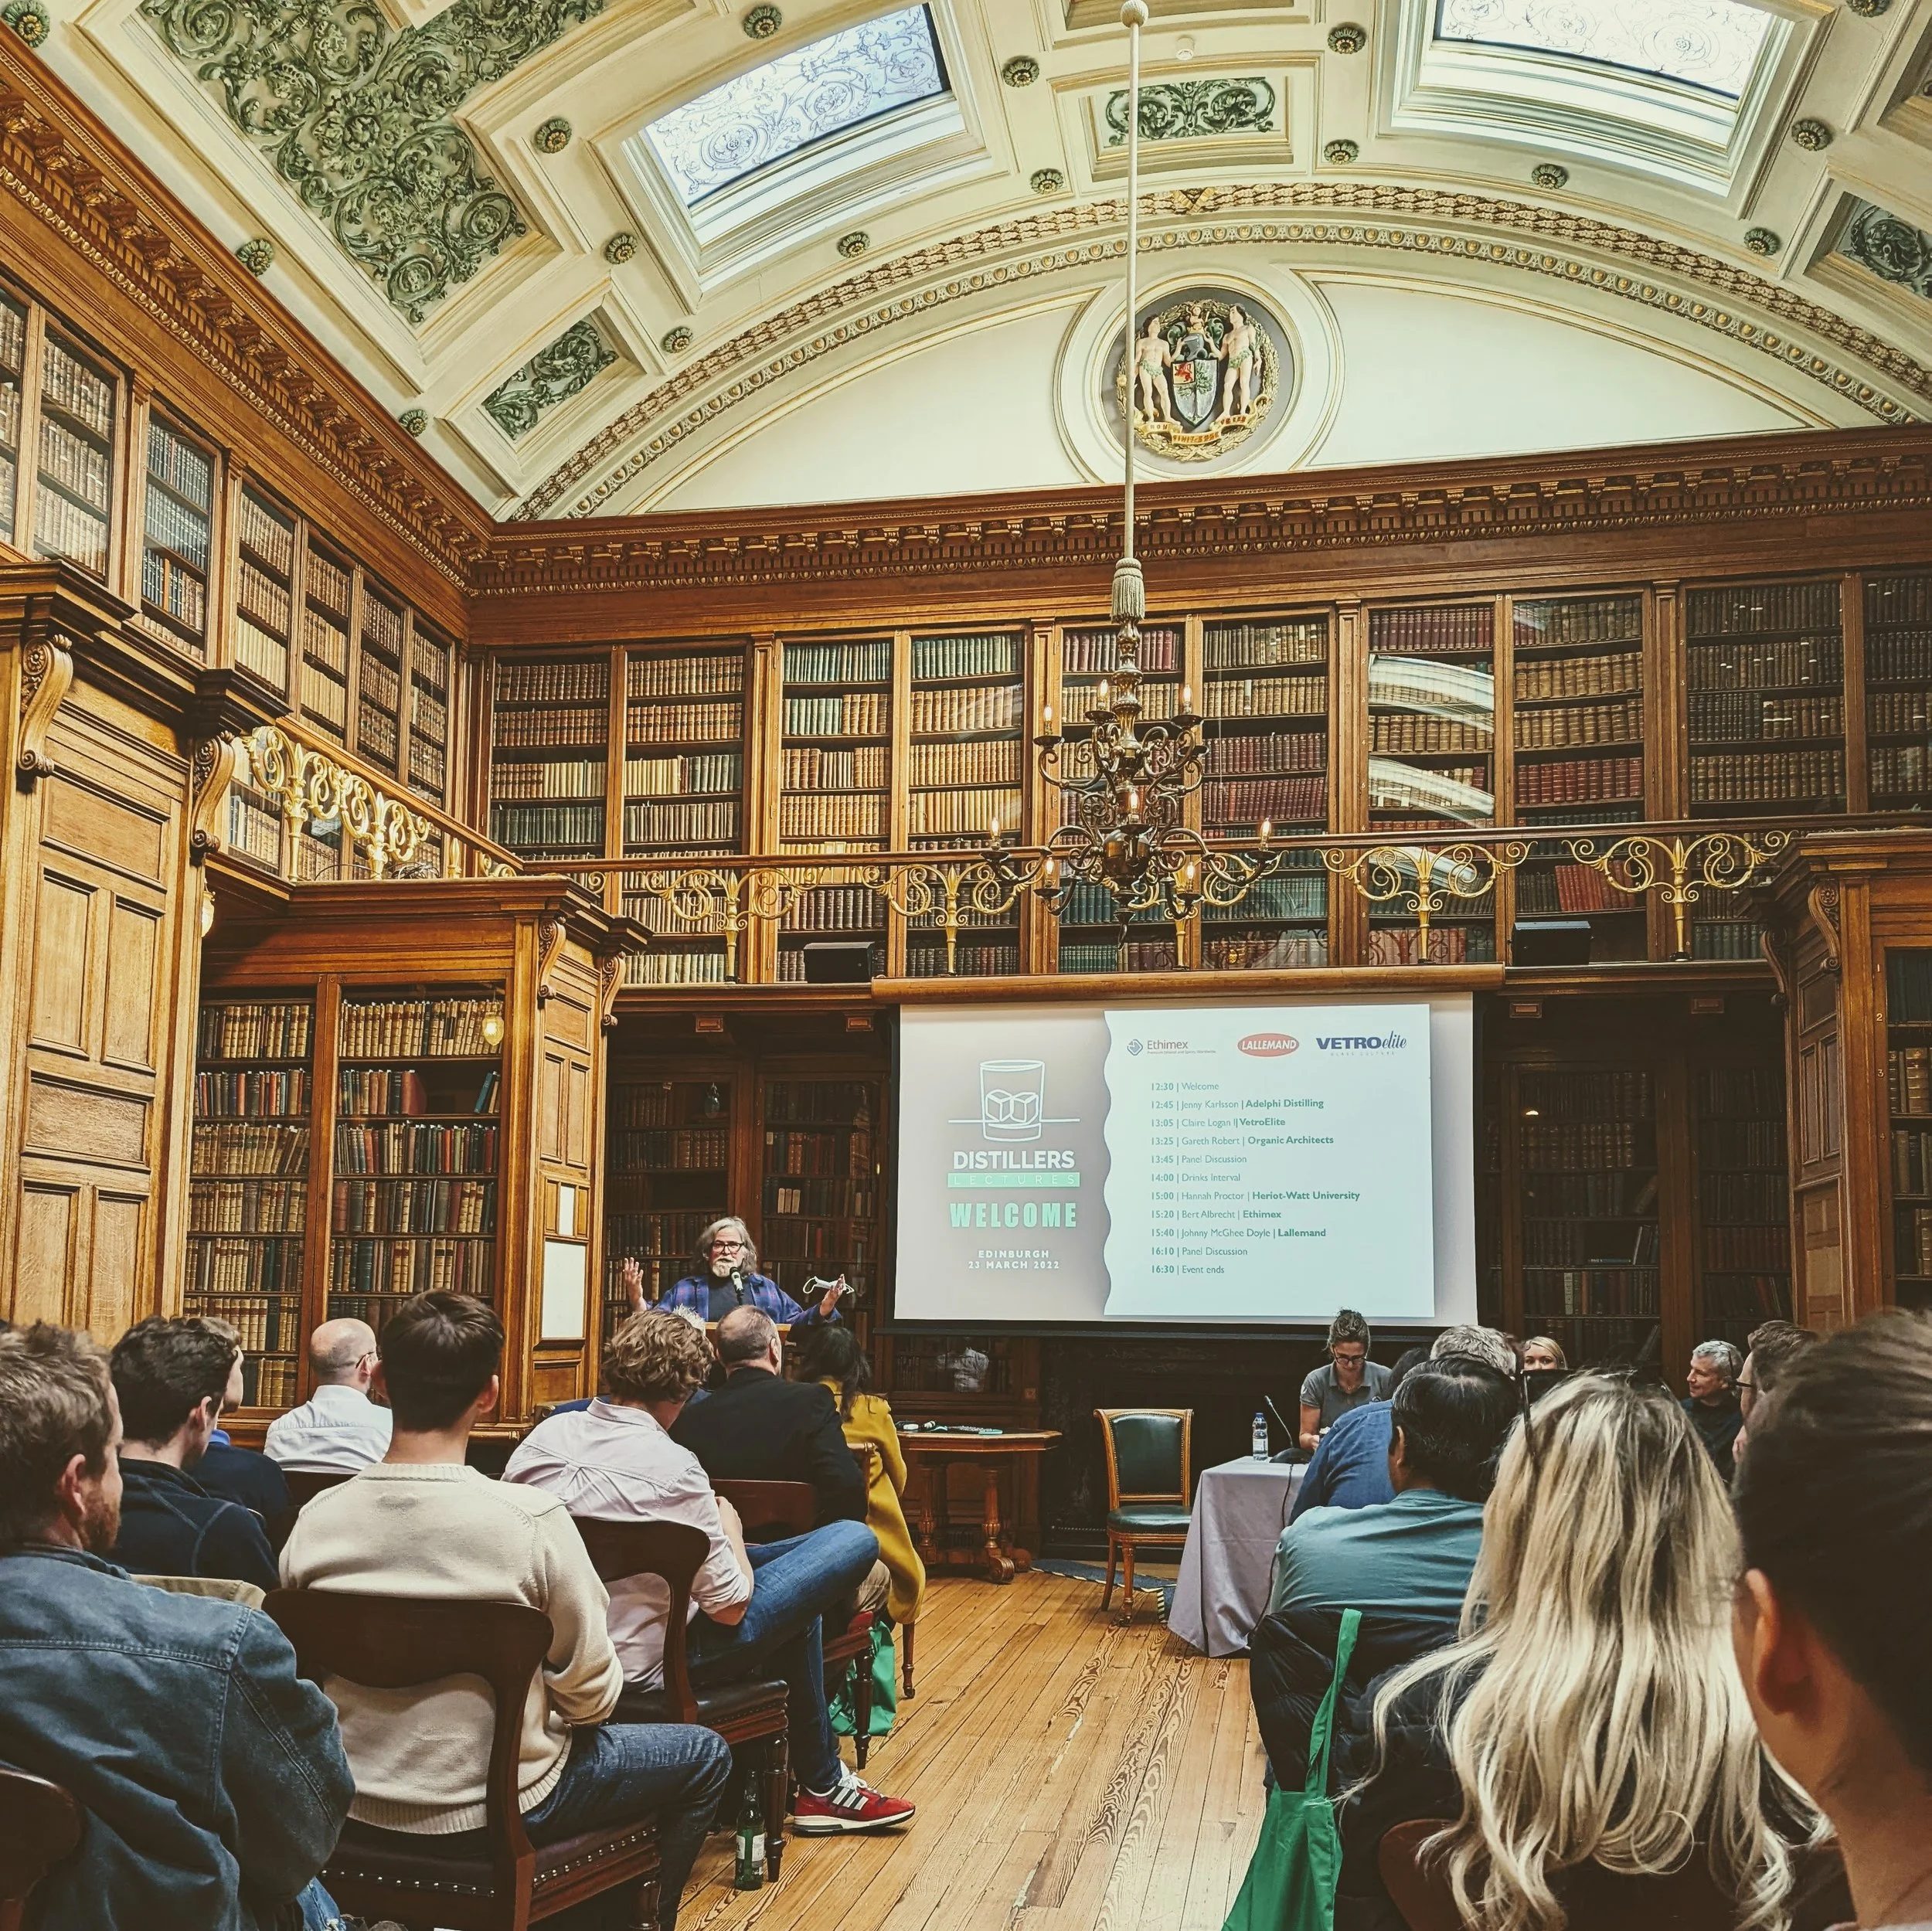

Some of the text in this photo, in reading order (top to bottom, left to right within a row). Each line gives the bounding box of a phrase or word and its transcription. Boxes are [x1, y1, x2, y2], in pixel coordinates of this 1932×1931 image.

[1147, 1039, 1189, 1049] Ethimex
[1241, 1039, 1297, 1050] LALLEMAND
[1151, 1081, 1175, 1092] 12:30
[1181, 1082, 1219, 1091] Welcome
[1151, 1100, 1175, 1110] 12:45
[1180, 1100, 1202, 1111] Jenny
[1205, 1100, 1240, 1109] Karlsson
[1245, 1099, 1281, 1110] Adelphi
[1283, 1098, 1325, 1110] Distilling
[1151, 1118, 1175, 1128] 13:05
[1181, 1118, 1206, 1127] Claire
[1207, 1118, 1231, 1130] Logan
[1239, 1117, 1287, 1127] VetroElite
[1151, 1137, 1175, 1146] 13:25
[1181, 1136, 1210, 1146] Gareth
[1211, 1136, 1240, 1145] Robert
[1247, 1135, 1285, 1147] Organic
[1285, 1135, 1335, 1144] Architects
[953, 1151, 1076, 1170] DISTILLERS
[1151, 1154, 1175, 1164] 13:45
[1181, 1154, 1202, 1164] Panel
[1205, 1154, 1247, 1164] Discussion
[954, 1175, 1075, 1185] LECTURES
[1151, 1173, 1175, 1182] 14:00
[1182, 1173, 1209, 1182] Drinks
[1210, 1172, 1241, 1181] Interval
[1151, 1191, 1175, 1201] 15:00
[1181, 1191, 1212, 1200] Hannah
[1213, 1191, 1245, 1200] Proctor
[1252, 1190, 1311, 1200] Heriot-Watt
[1312, 1189, 1361, 1202] University
[950, 1202, 1077, 1228] WELCOME
[1151, 1209, 1175, 1219] 15:20
[1182, 1209, 1200, 1219] Bert
[1200, 1209, 1236, 1219] Albrecht
[1242, 1209, 1282, 1219] Ethimex
[1151, 1228, 1175, 1237] 15:40
[1180, 1228, 1209, 1239] Johnny
[1210, 1228, 1245, 1237] McGhee
[1246, 1227, 1271, 1239] Doyle
[1277, 1228, 1327, 1237] Lallemand
[978, 1249, 1049, 1259] EDINBURGH
[1151, 1246, 1175, 1256] 16:10
[1182, 1246, 1203, 1256] Panel
[1205, 1246, 1248, 1256] Discussion
[968, 1260, 1060, 1270] 23 MARCH 2022
[1151, 1264, 1175, 1274] 16:30
[1182, 1264, 1204, 1274] Event
[1206, 1264, 1225, 1274] ends
